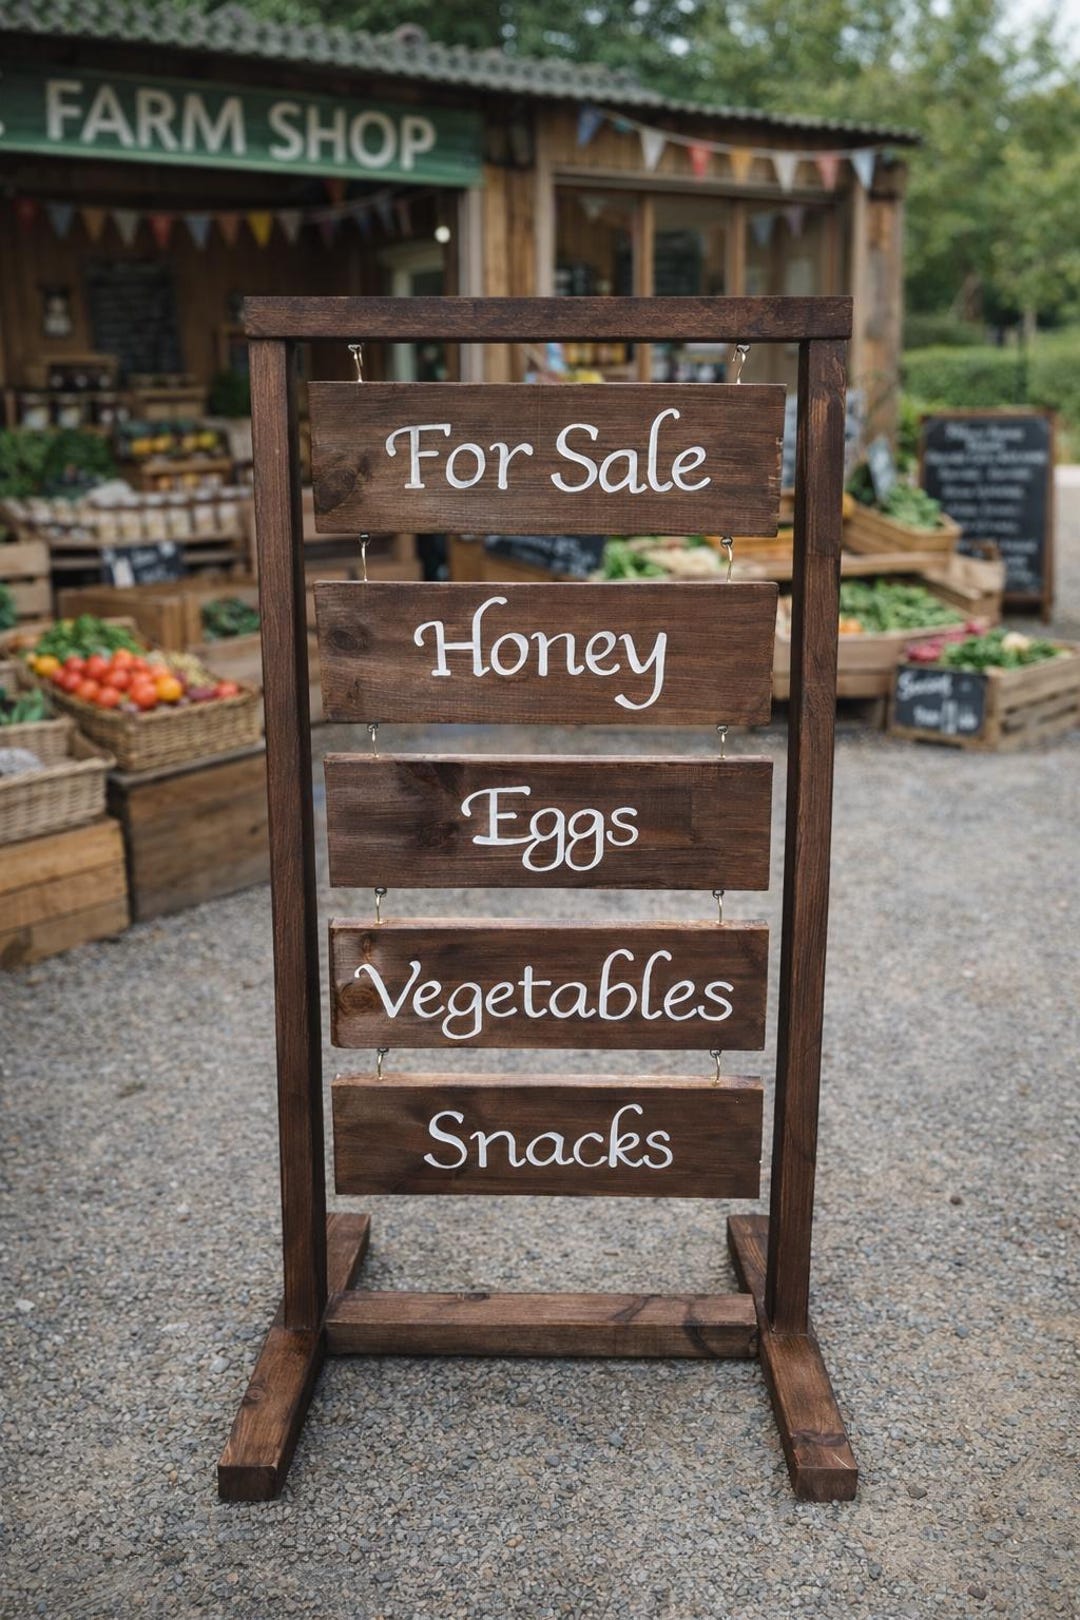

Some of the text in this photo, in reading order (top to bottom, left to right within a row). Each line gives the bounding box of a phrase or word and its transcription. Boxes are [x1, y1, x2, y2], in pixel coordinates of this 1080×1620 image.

[45, 79, 248, 155] FARM
[267, 101, 437, 171] SHOP
[386, 408, 711, 493] For Sale
[414, 597, 667, 710] Honey
[461, 786, 638, 871] Eggs
[354, 949, 733, 1039] Vegetables
[424, 1104, 672, 1168] Snacks
